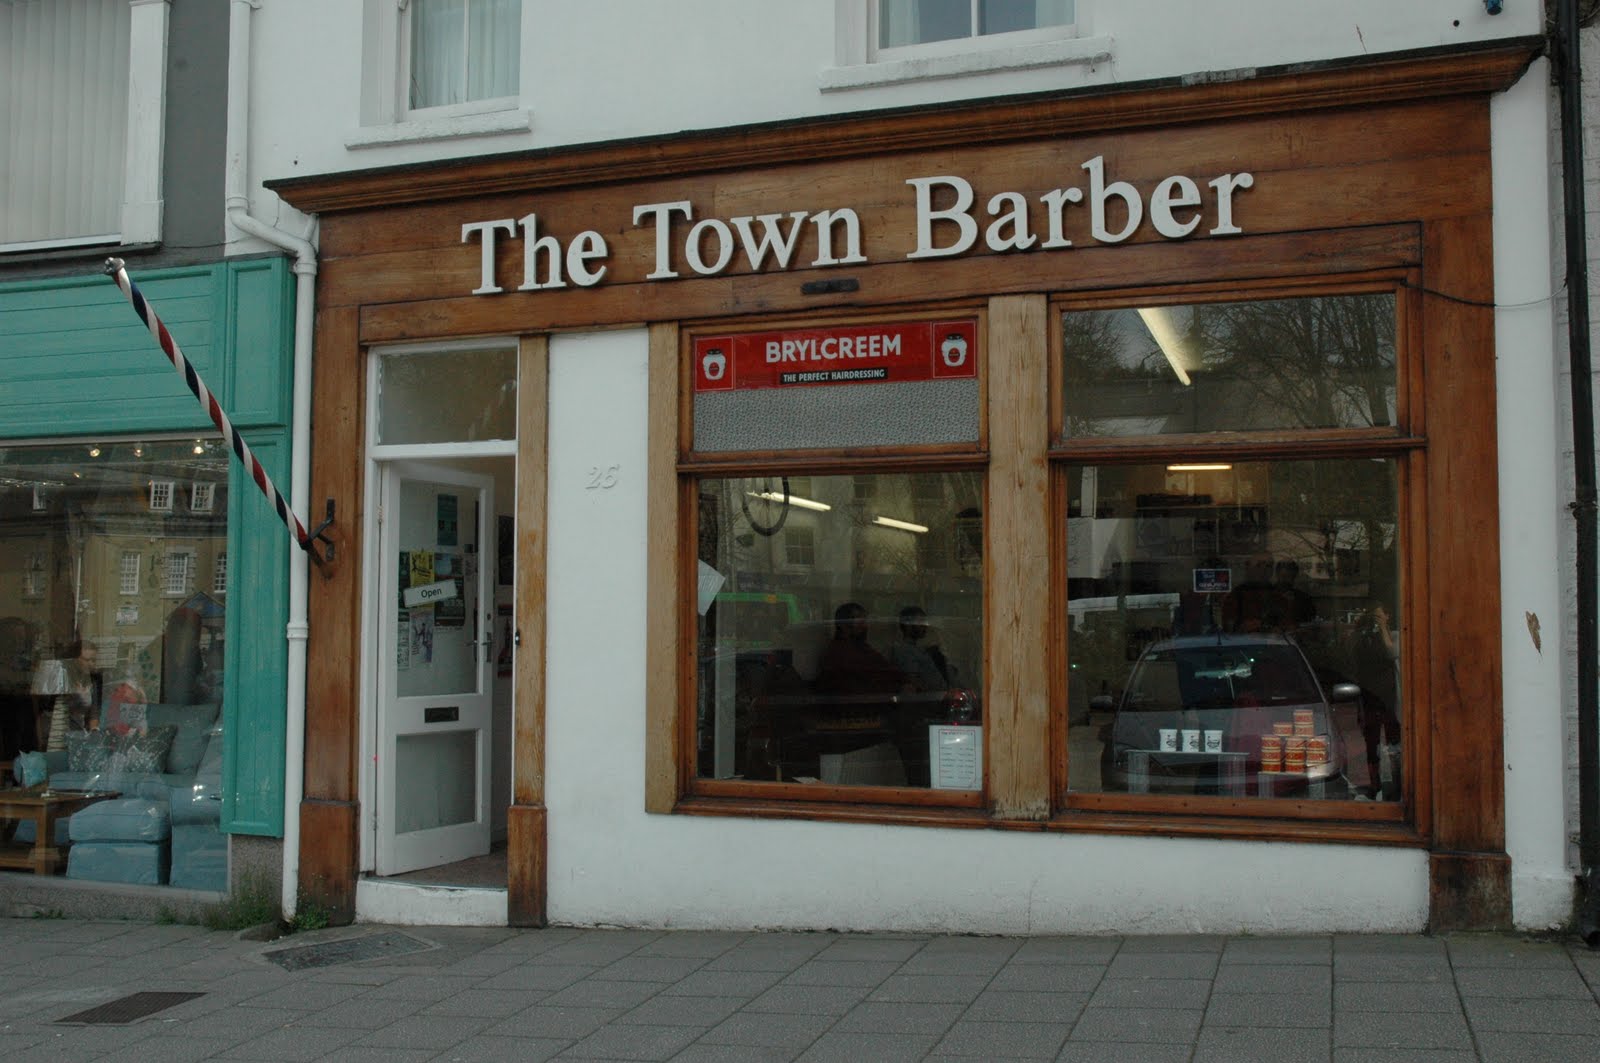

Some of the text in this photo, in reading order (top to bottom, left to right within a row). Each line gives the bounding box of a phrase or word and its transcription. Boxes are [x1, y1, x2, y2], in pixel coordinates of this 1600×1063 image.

[461, 155, 1255, 295] The Town Barber
[765, 333, 902, 363] BRYLCREEM
[783, 369, 885, 383] THE PERFECT HAIRDRESSING
[420, 588, 442, 599] Open
